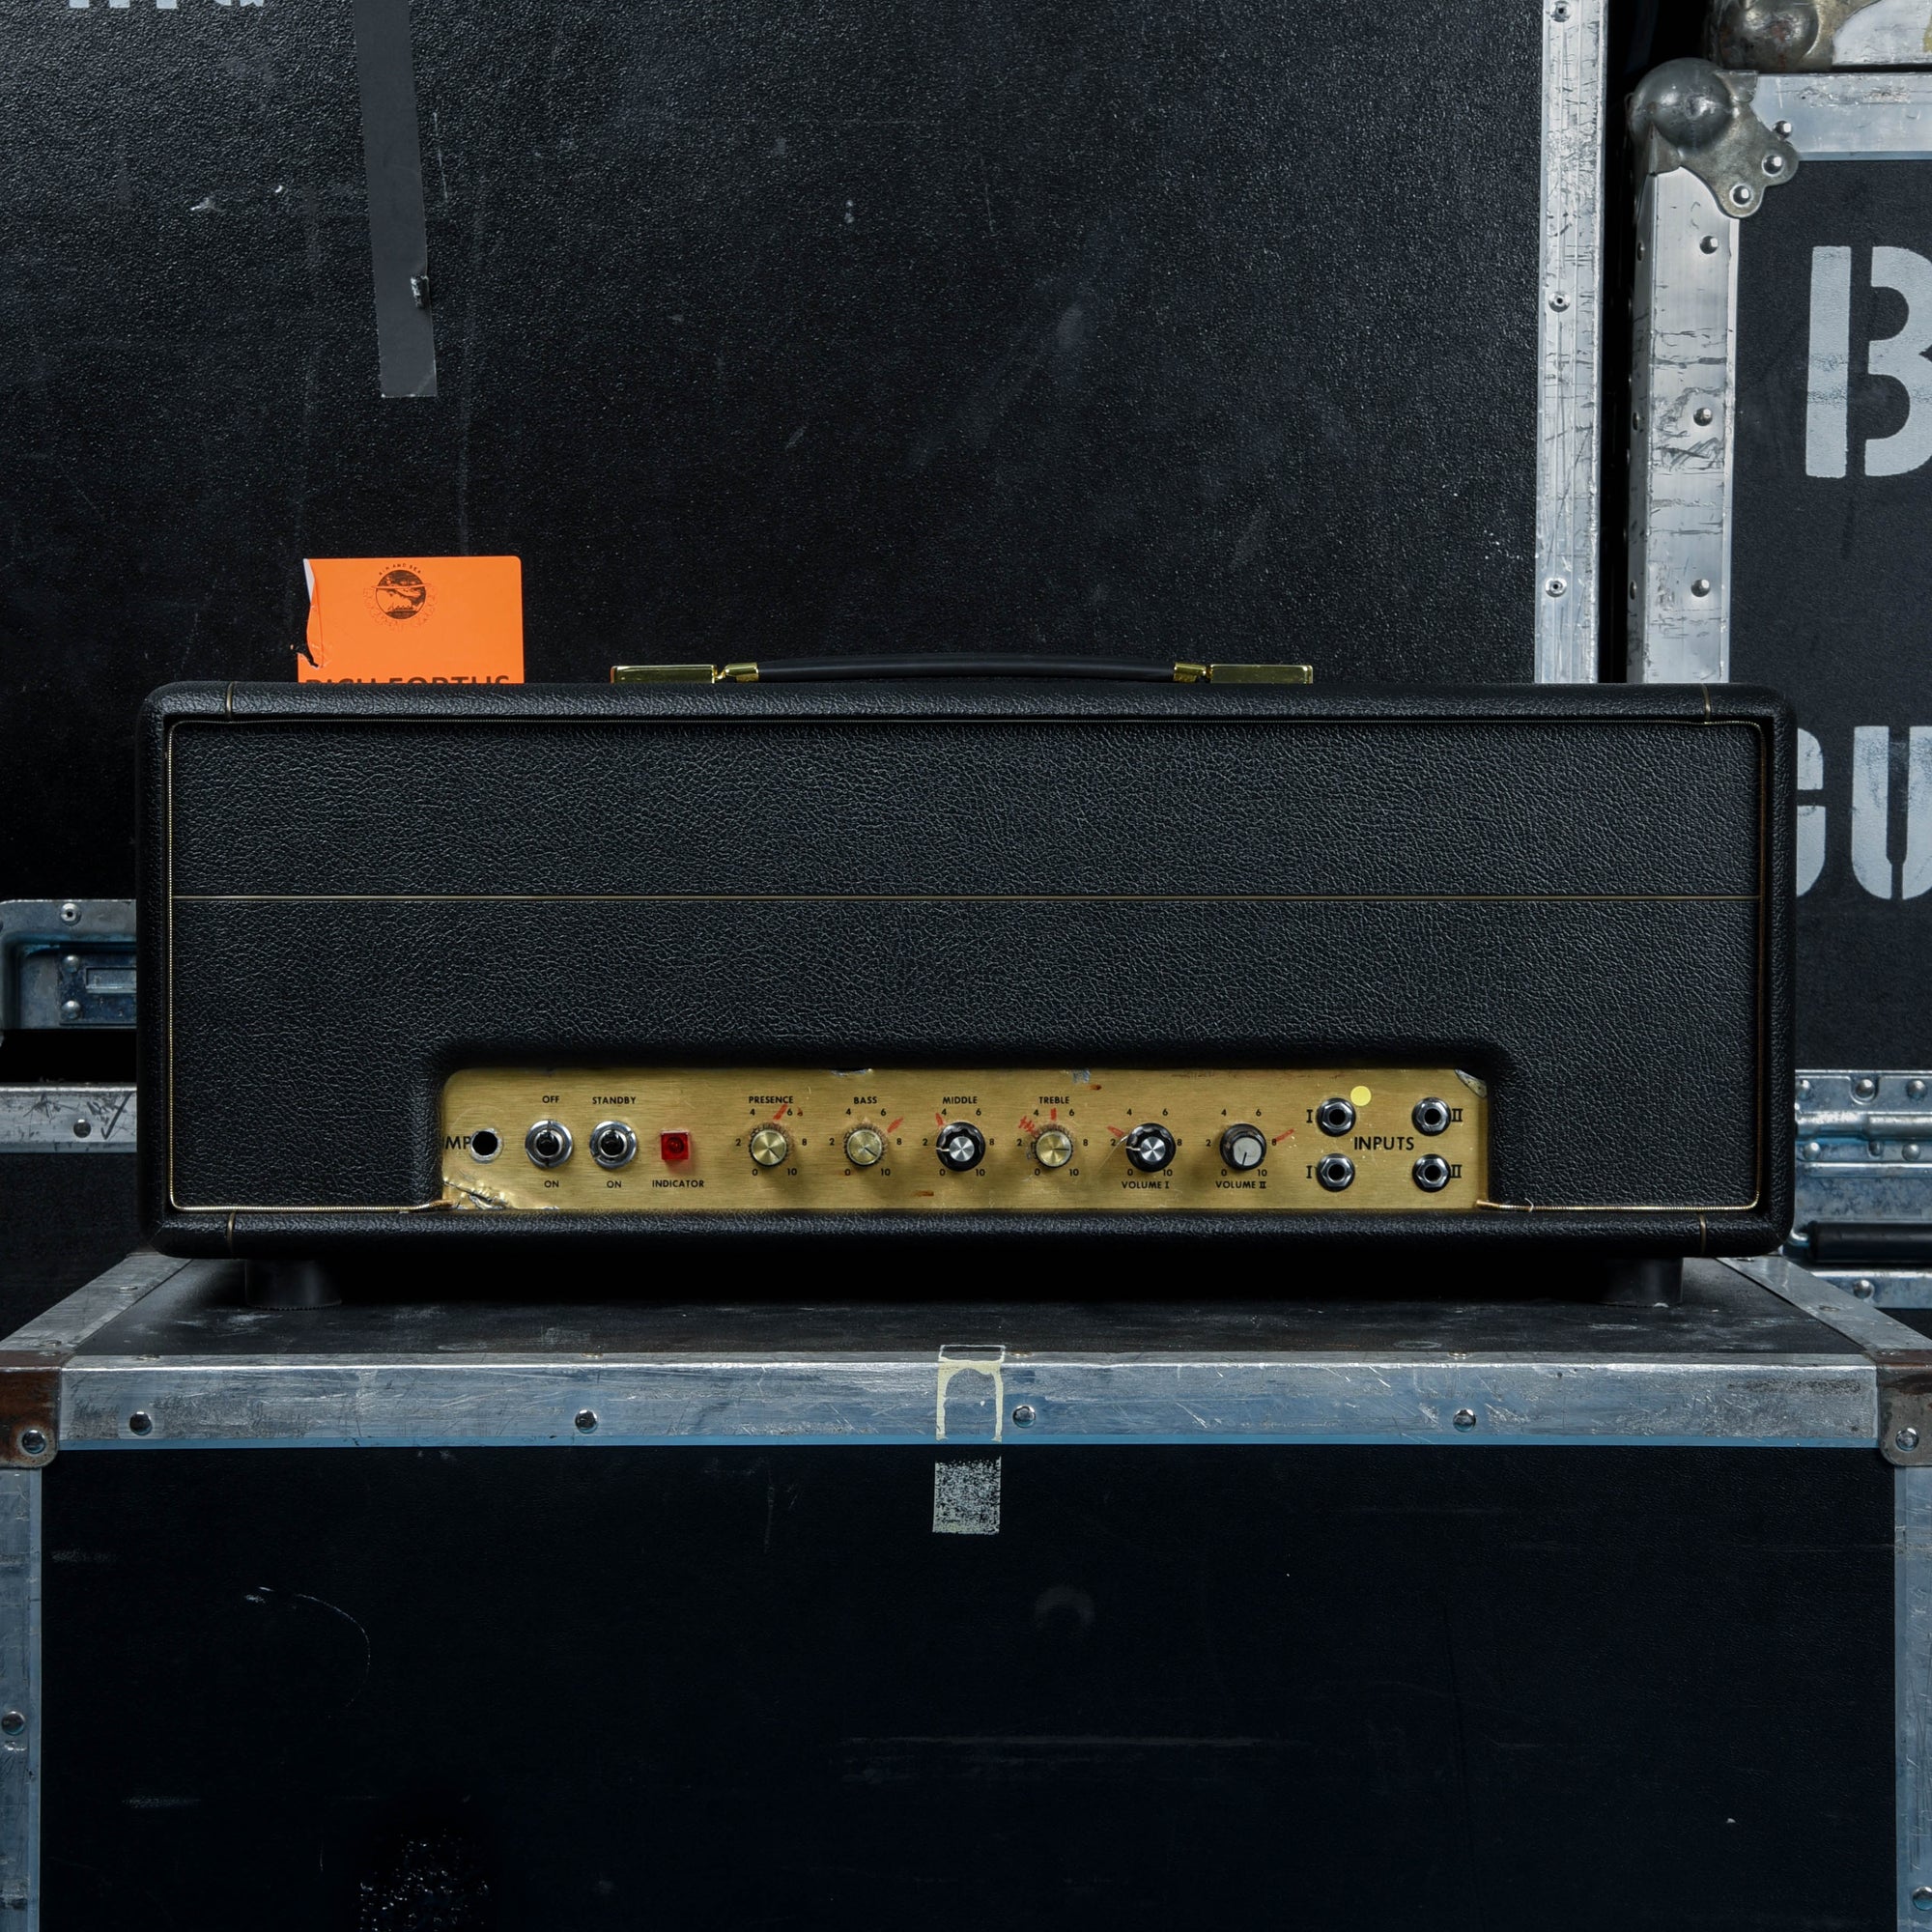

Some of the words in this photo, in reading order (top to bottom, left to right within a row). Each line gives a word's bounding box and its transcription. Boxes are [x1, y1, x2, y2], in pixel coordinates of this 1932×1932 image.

[542, 1094, 560, 1104] OFF
[592, 1096, 637, 1105] STANDBY
[749, 1095, 793, 1104] PRESENCE
[442, 1136, 471, 1150] MP
[1354, 1137, 1414, 1151] INPUTS
[544, 1179, 559, 1188] ON
[652, 1179, 704, 1188] INDICATOR
[1121, 1180, 1162, 1189] VOLUME
[1215, 1180, 1256, 1189] VOLUME
